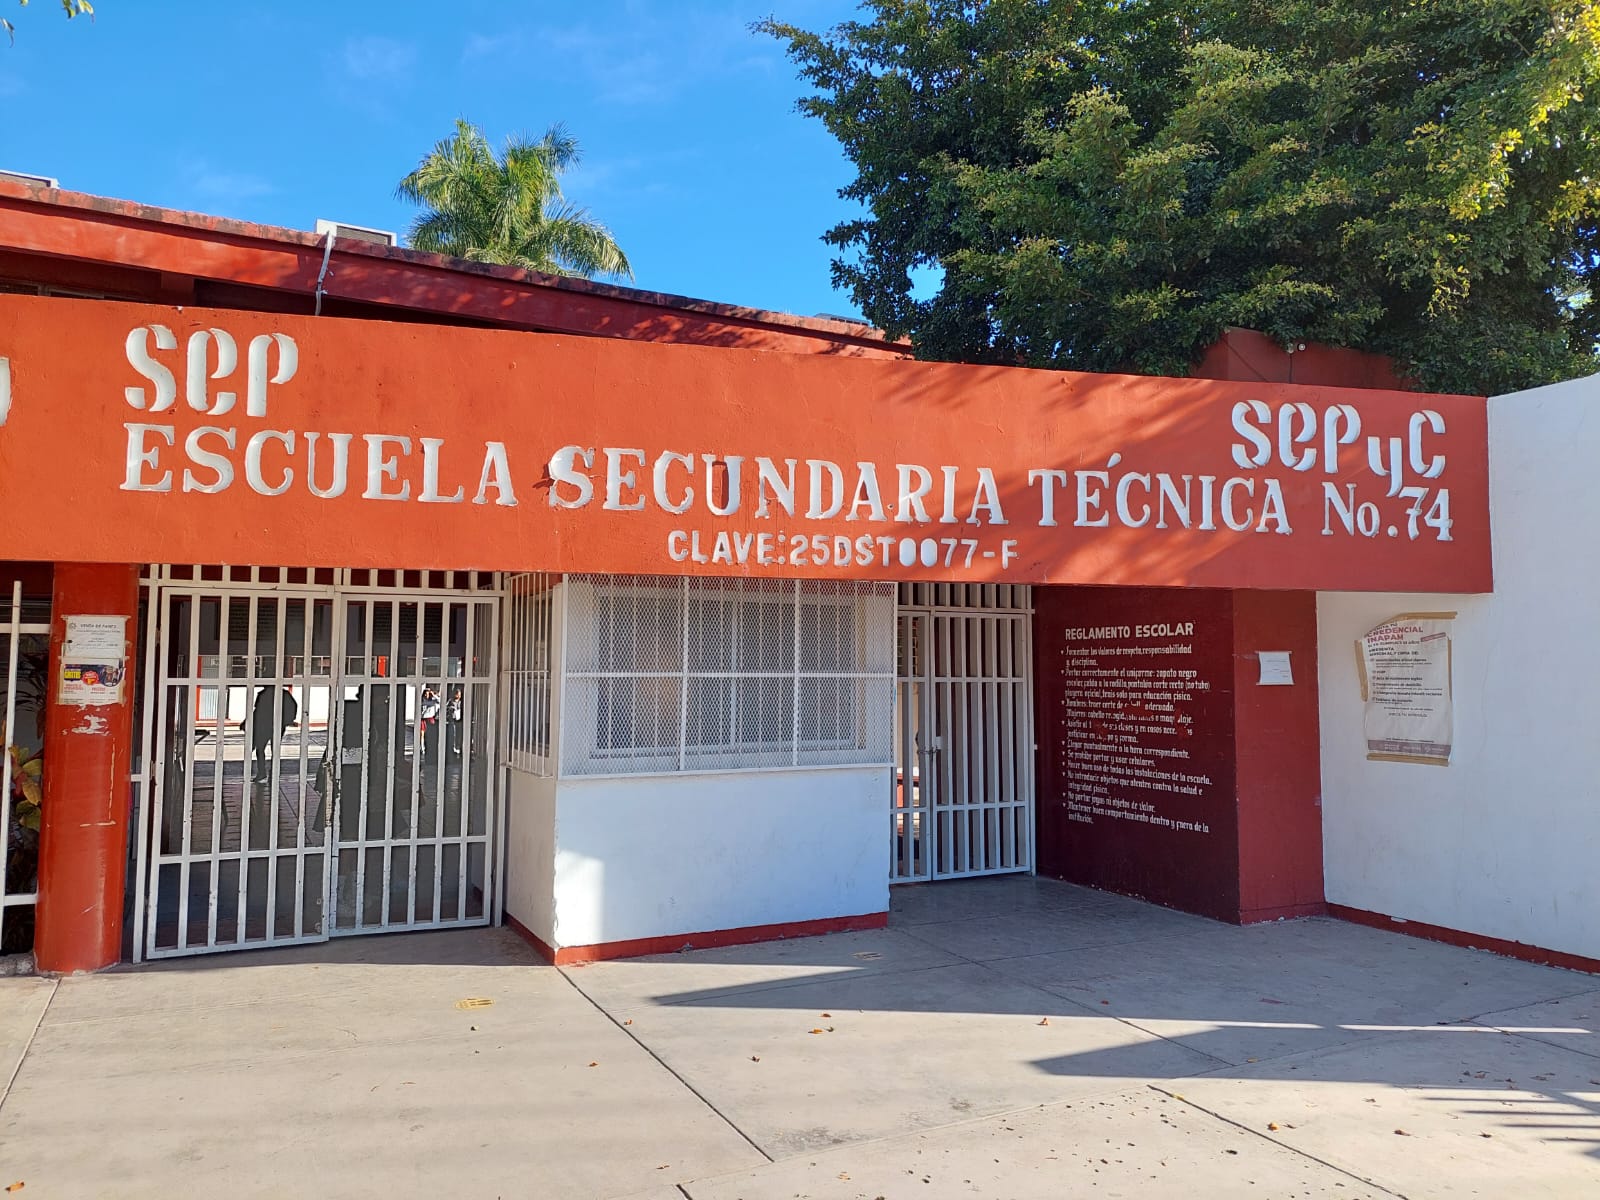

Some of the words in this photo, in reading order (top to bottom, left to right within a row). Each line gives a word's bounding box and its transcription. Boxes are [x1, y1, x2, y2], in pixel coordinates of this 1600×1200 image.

[119, 422, 518, 507] ESCUELA
[546, 444, 1010, 529] SECUNDARIA
[1028, 452, 1294, 537] TÉCNICA
[1065, 626, 1130, 640] REGLAMENTO
[1135, 622, 1193, 638] ESCOLAR
[1367, 626, 1424, 637] CREDENCIAL
[1367, 634, 1404, 644] INAPAM
[1116, 646, 1122, 655] de
[1071, 657, 1098, 668] disciplina.
[1081, 668, 1119, 677] correctamente
[1120, 667, 1126, 677] el
[1156, 668, 1177, 679] zapato
[1178, 669, 1197, 680] negro
[1103, 678, 1108, 688] la
[1153, 680, 1168, 689] corte
[1169, 680, 1184, 689] recto
[1185, 680, 1195, 691] (no
[1116, 690, 1128, 699] solo
[1128, 692, 1142, 702] para
[1143, 690, 1172, 700] educación
[1173, 690, 1193, 703] física.
[1088, 699, 1102, 708] traer
[1102, 700, 1116, 709] corte
[1116, 700, 1123, 709] de
[1147, 726, 1163, 734] casos
[1119, 735, 1139, 745] forma.
[1083, 742, 1118, 753] puntualmente
[1123, 744, 1129, 753] la
[1130, 745, 1143, 754] hora
[1143, 747, 1190, 759] correspondiente.
[1067, 749, 1074, 758] Se
[1093, 753, 1110, 763] portar
[1129, 756, 1156, 767] celulares.
[1081, 761, 1093, 770] buen
[1103, 764, 1110, 772] de
[1110, 765, 1125, 774] todas
[1125, 766, 1133, 775] las
[1134, 766, 1171, 780] instalaciones
[1171, 772, 1178, 781] de
[1179, 772, 1186, 782] la
[1186, 774, 1213, 785] escuela.
[1068, 781, 1092, 792] integridad
[1074, 772, 1099, 782] introducir
[1100, 775, 1119, 785] objetos
[1119, 779, 1129, 789] que
[1130, 778, 1152, 789] atenten
[1153, 781, 1172, 792] contra
[1173, 783, 1179, 793] la
[1180, 785, 1198, 795] salud
[1075, 793, 1091, 803] portar
[1105, 796, 1111, 806] ni
[1112, 797, 1130, 808] objetos
[1131, 800, 1138, 810] de
[1092, 806, 1105, 815] buen
[1105, 809, 1149, 823] comportamiento
[1150, 814, 1170, 826] dentro
[1176, 820, 1193, 832] fuera
[1194, 821, 1202, 832] de
[1202, 822, 1209, 833] la
